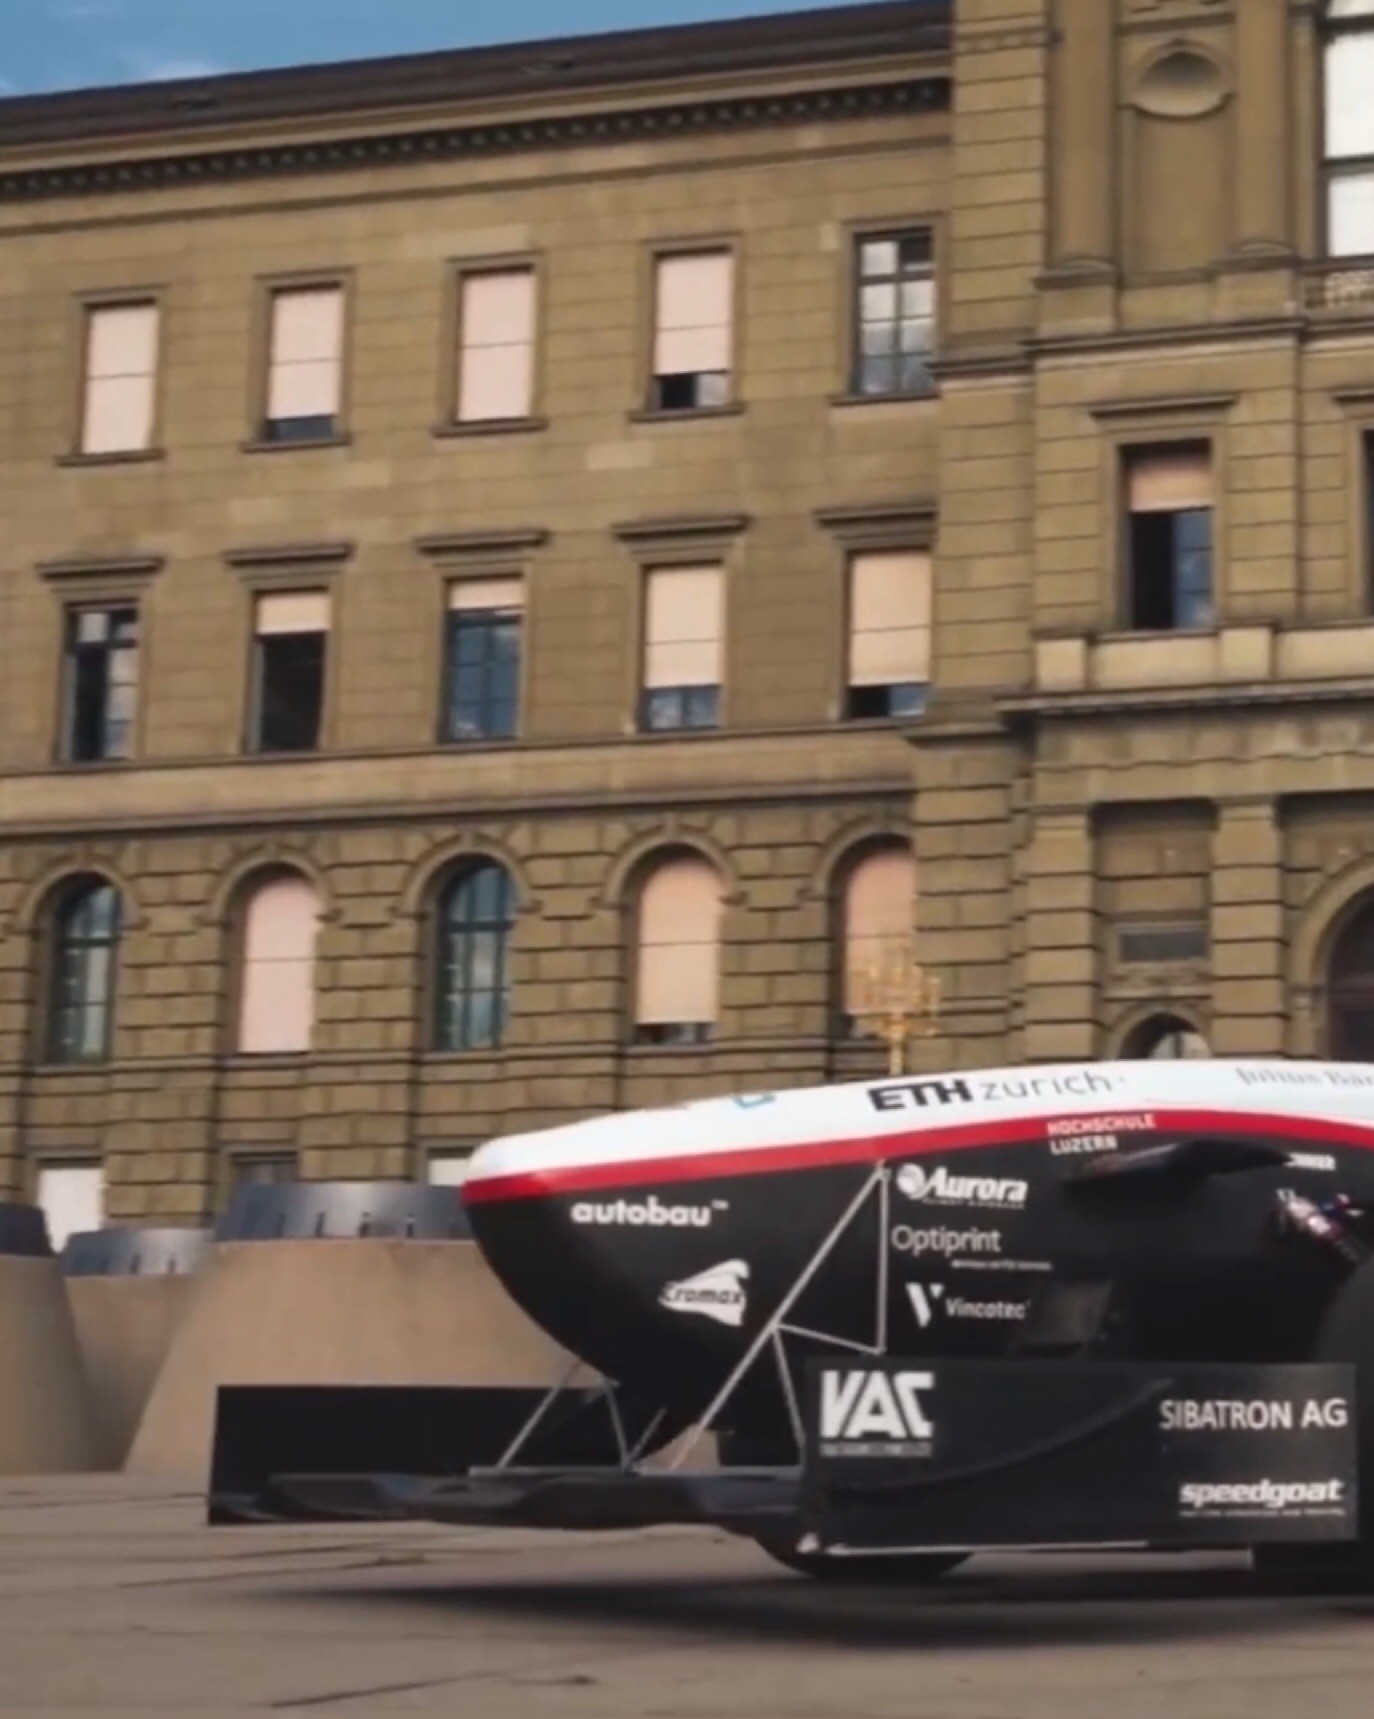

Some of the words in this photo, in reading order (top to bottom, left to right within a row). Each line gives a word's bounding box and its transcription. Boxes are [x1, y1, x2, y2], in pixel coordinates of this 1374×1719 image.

[867, 1079, 974, 1113] ETH
[1046, 1113, 1157, 1136] HOCHSCHULE
[1050, 1135, 1118, 1155] LUZERN
[919, 1166, 1028, 1203] Aurora
[891, 1224, 1003, 1257] Optiprint
[1159, 1399, 1293, 1430] SIBATRON
[1302, 1397, 1348, 1428] AG
[1179, 1477, 1344, 1508] speedgoat
